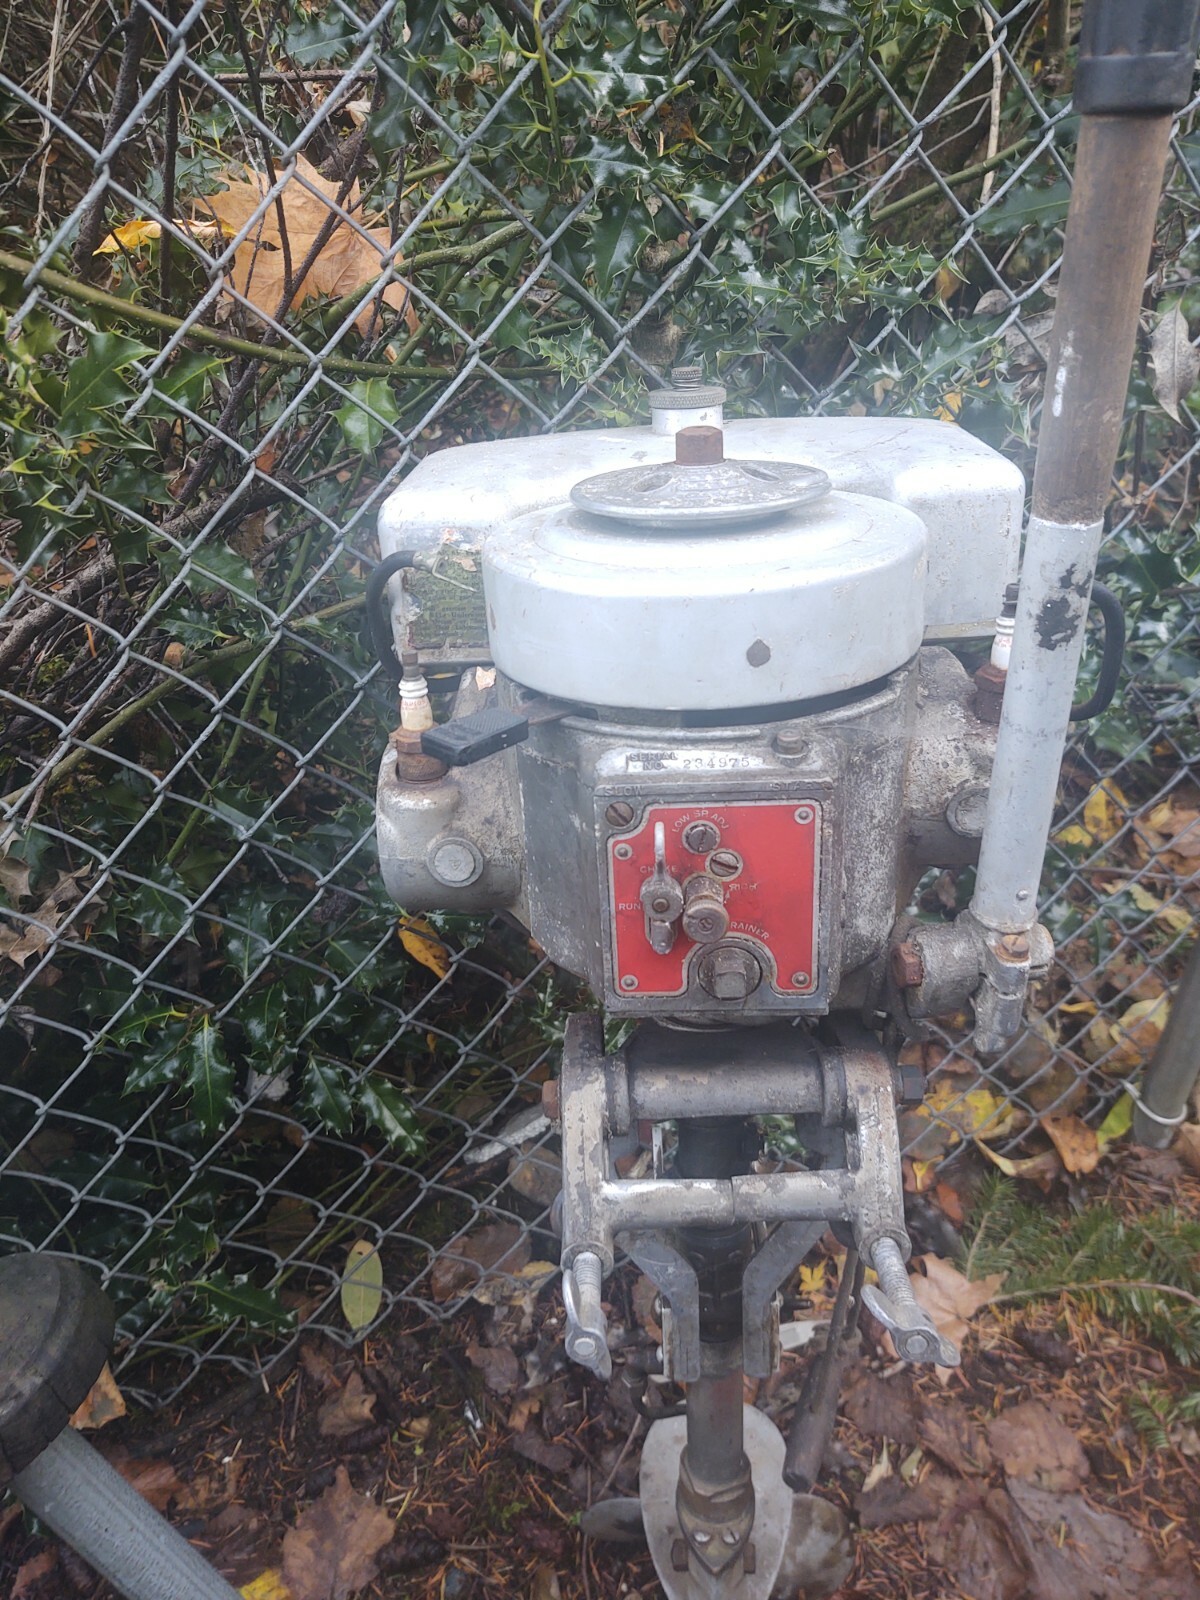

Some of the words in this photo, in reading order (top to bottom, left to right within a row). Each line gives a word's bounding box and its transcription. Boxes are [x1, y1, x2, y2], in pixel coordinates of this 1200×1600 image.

[628, 752, 678, 761] SERIAL
[683, 754, 750, 769] 234975
[604, 785, 643, 796] SLOW
[672, 813, 690, 833] LOW
[711, 813, 730, 830] ADJ
[639, 865, 679, 874] CHKE
[618, 902, 641, 911] RUN
[730, 921, 770, 940] RAINER
